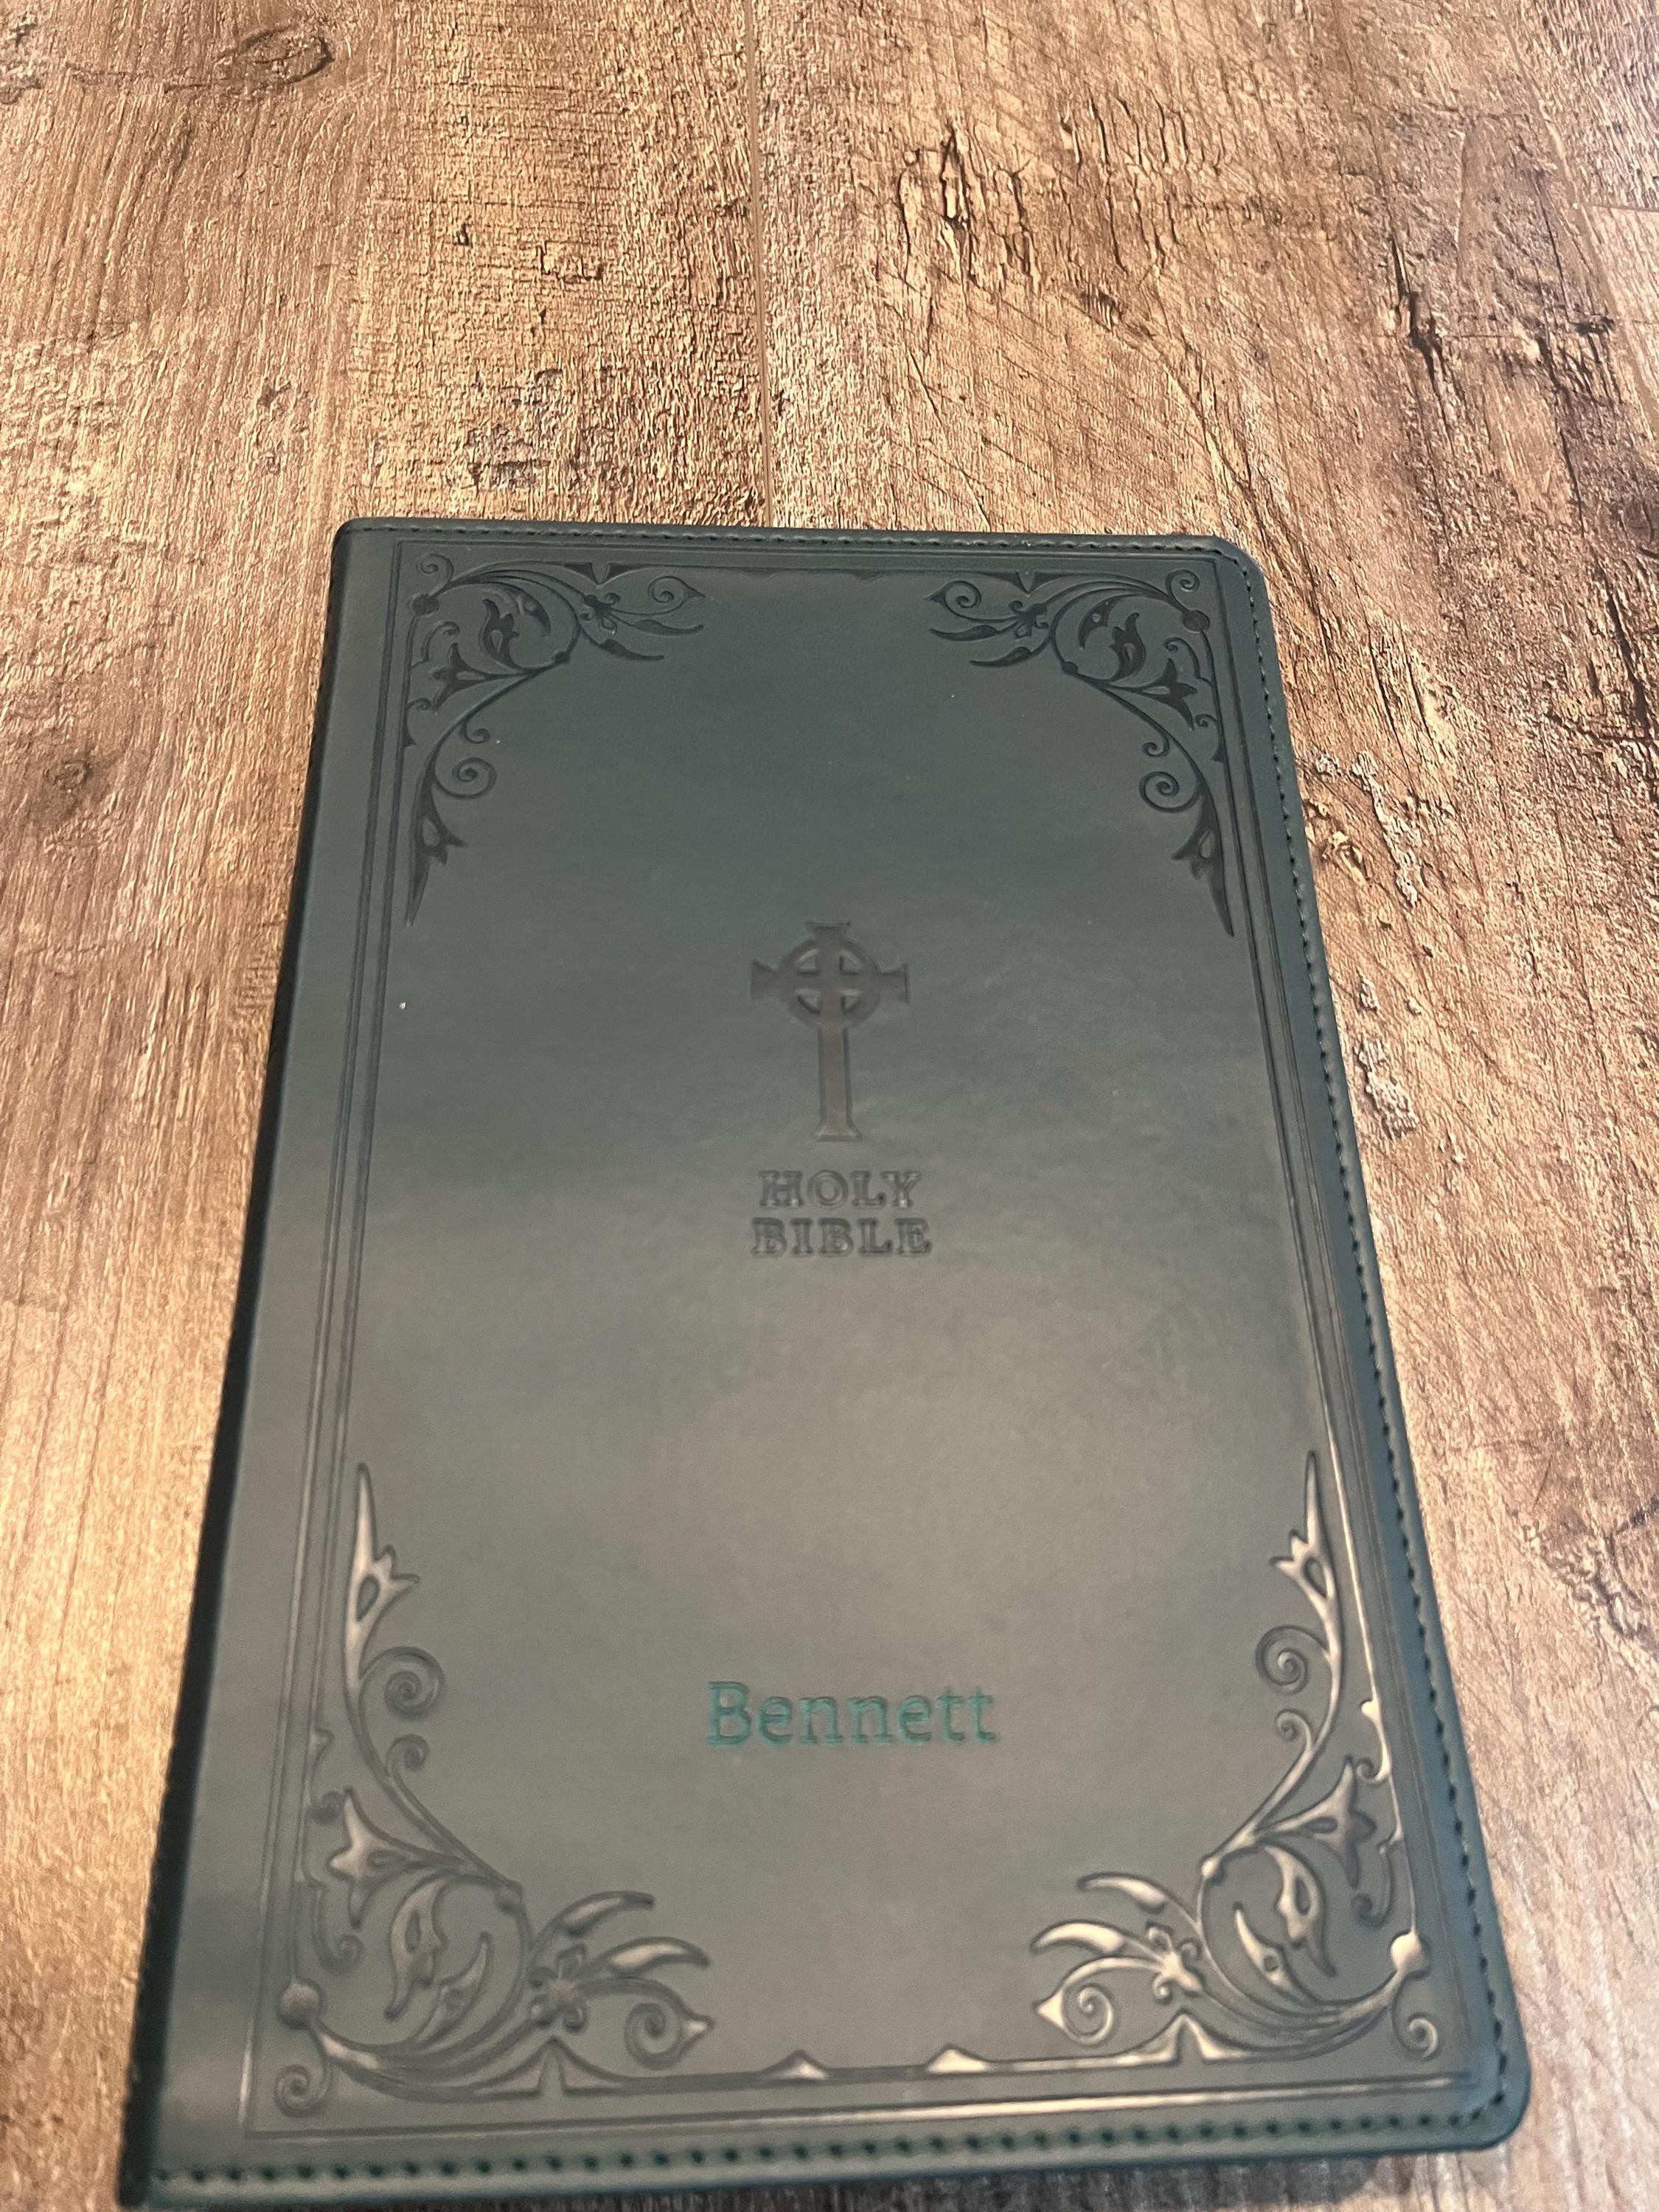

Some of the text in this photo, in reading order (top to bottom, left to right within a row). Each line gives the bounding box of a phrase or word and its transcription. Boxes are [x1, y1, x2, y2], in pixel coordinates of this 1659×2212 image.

[758, 1169, 922, 1208] HOLY
[751, 1217, 932, 1256] BIBLE
[707, 1680, 998, 1747] Bennett
